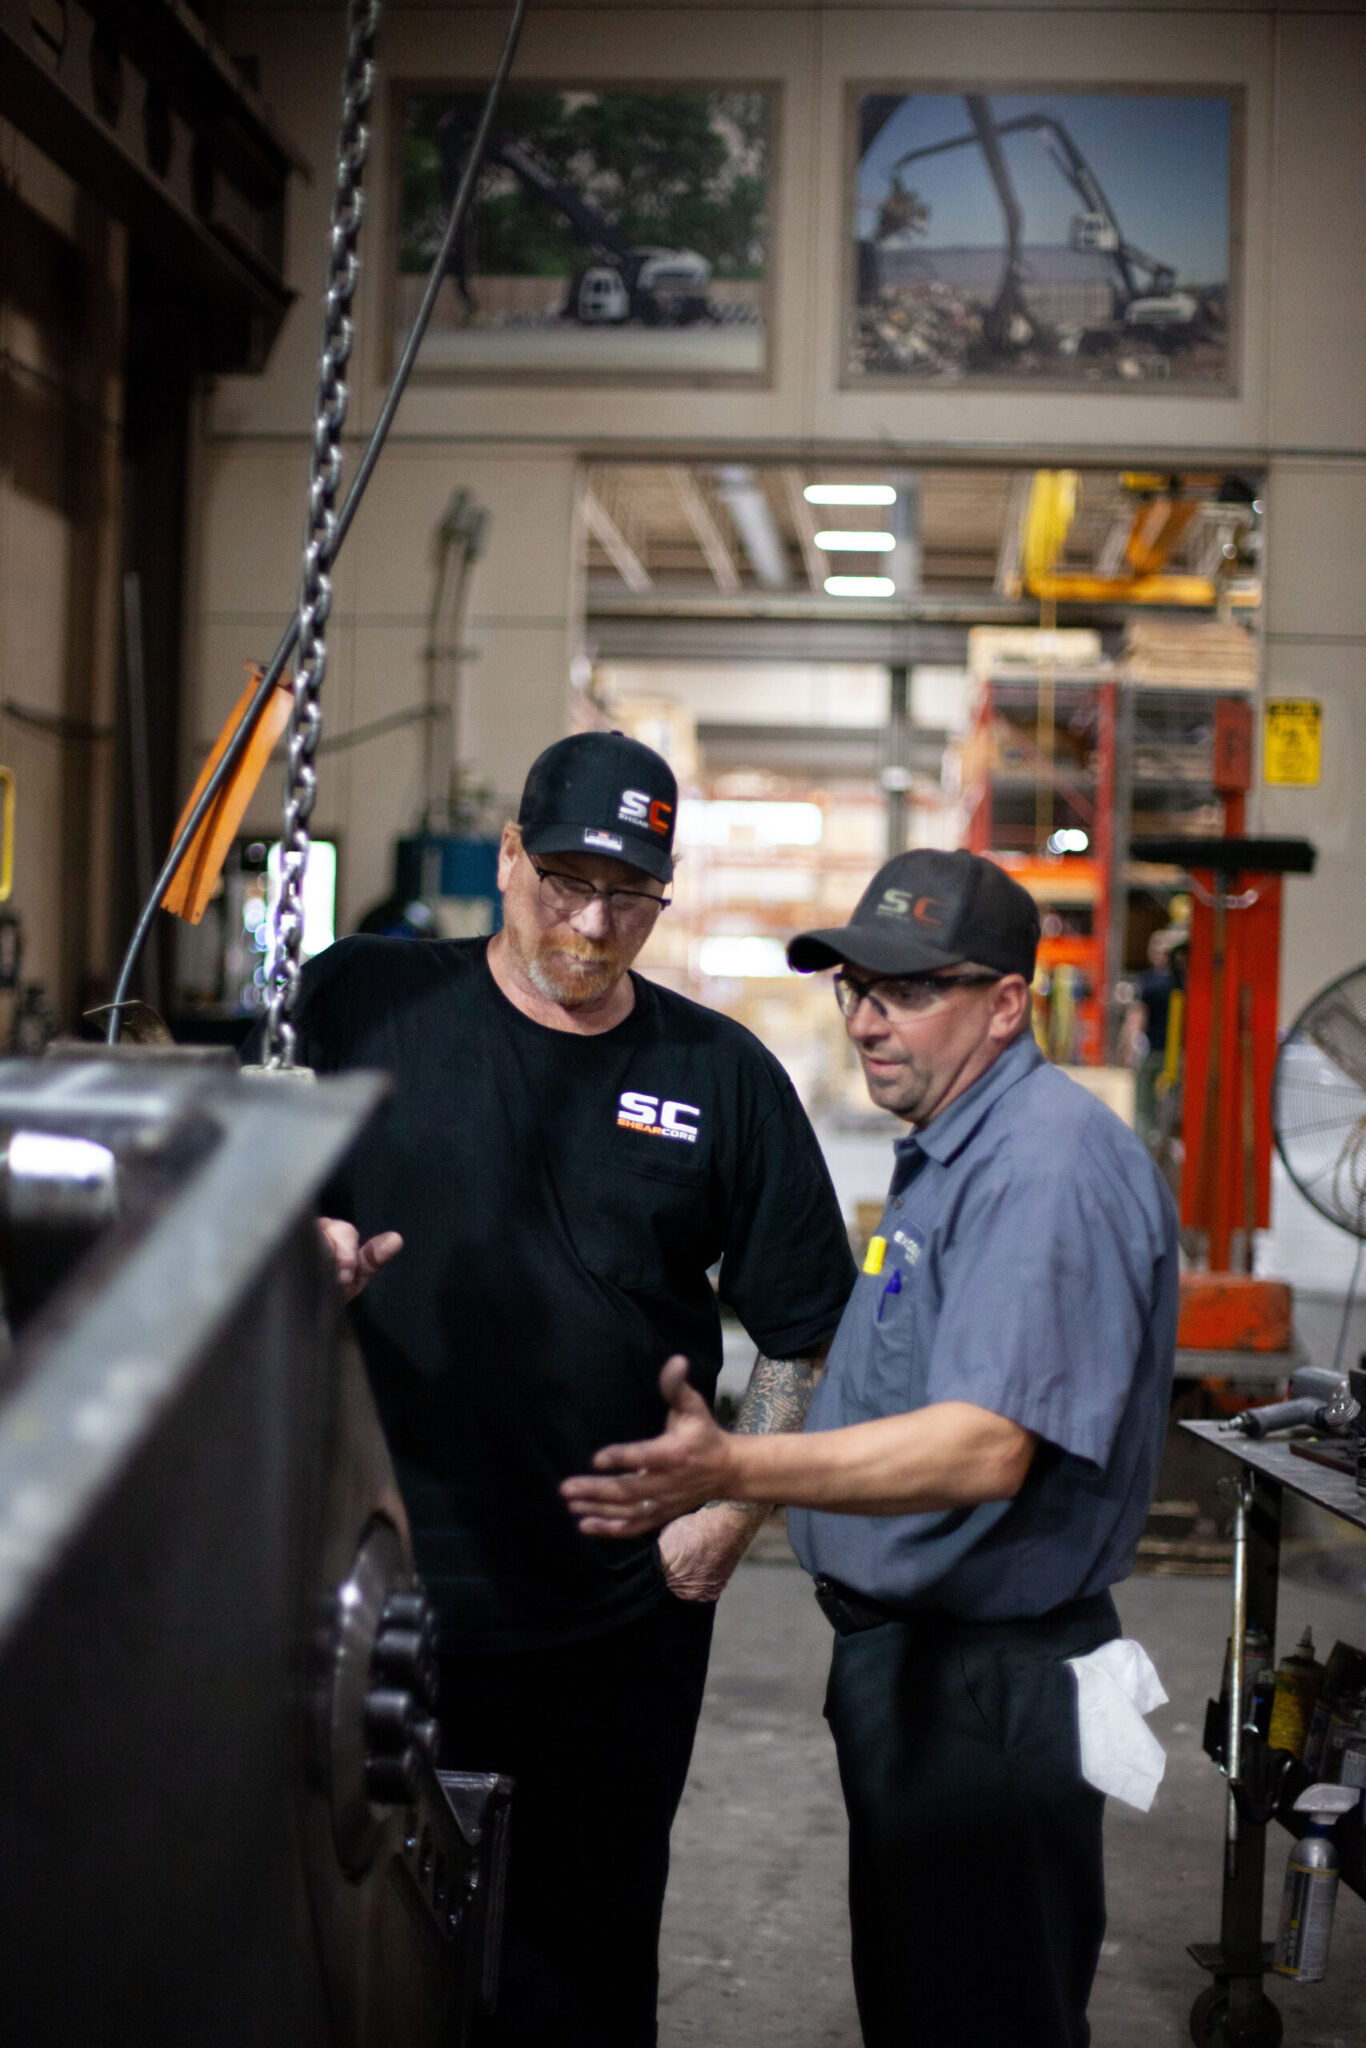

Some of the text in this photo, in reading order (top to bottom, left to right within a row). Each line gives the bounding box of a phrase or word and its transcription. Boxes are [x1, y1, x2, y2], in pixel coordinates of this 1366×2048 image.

[620, 790, 672, 828] SC
[878, 888, 943, 925] SC
[617, 1118, 697, 1143] SHEARCORE
[618, 1092, 700, 1135] SC
